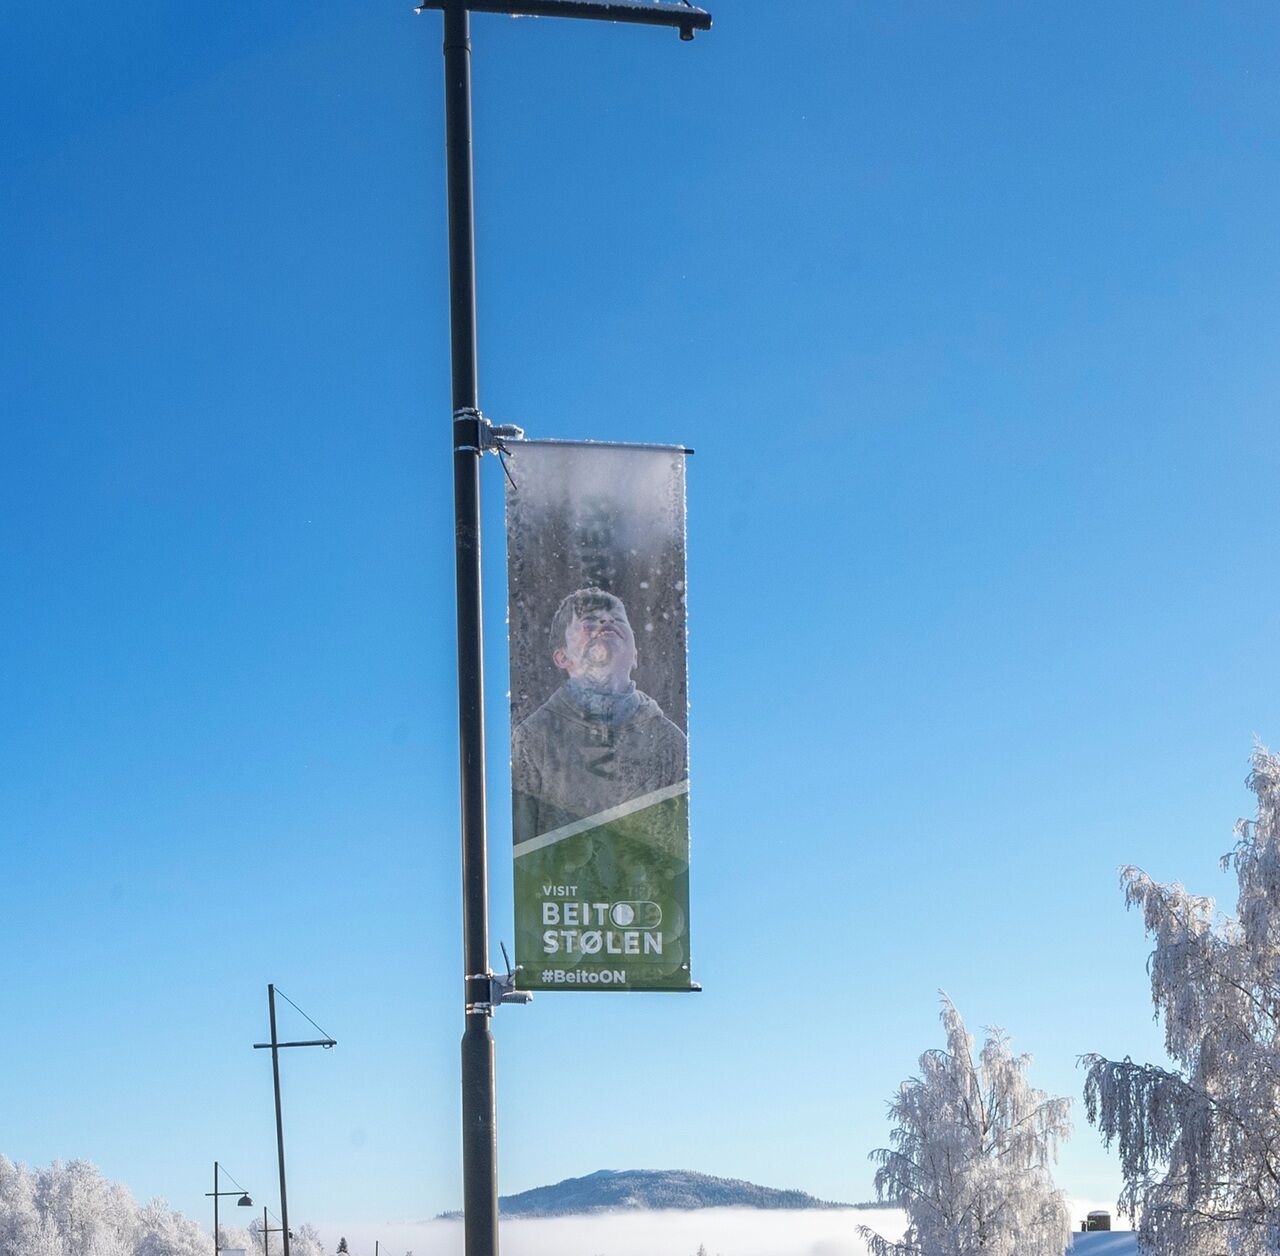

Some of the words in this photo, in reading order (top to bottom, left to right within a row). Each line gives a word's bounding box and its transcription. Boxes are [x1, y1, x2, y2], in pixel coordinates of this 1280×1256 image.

[542, 885, 578, 897] VISIT
[542, 930, 663, 954] STØLEN
[541, 969, 626, 983] #BeitoON
